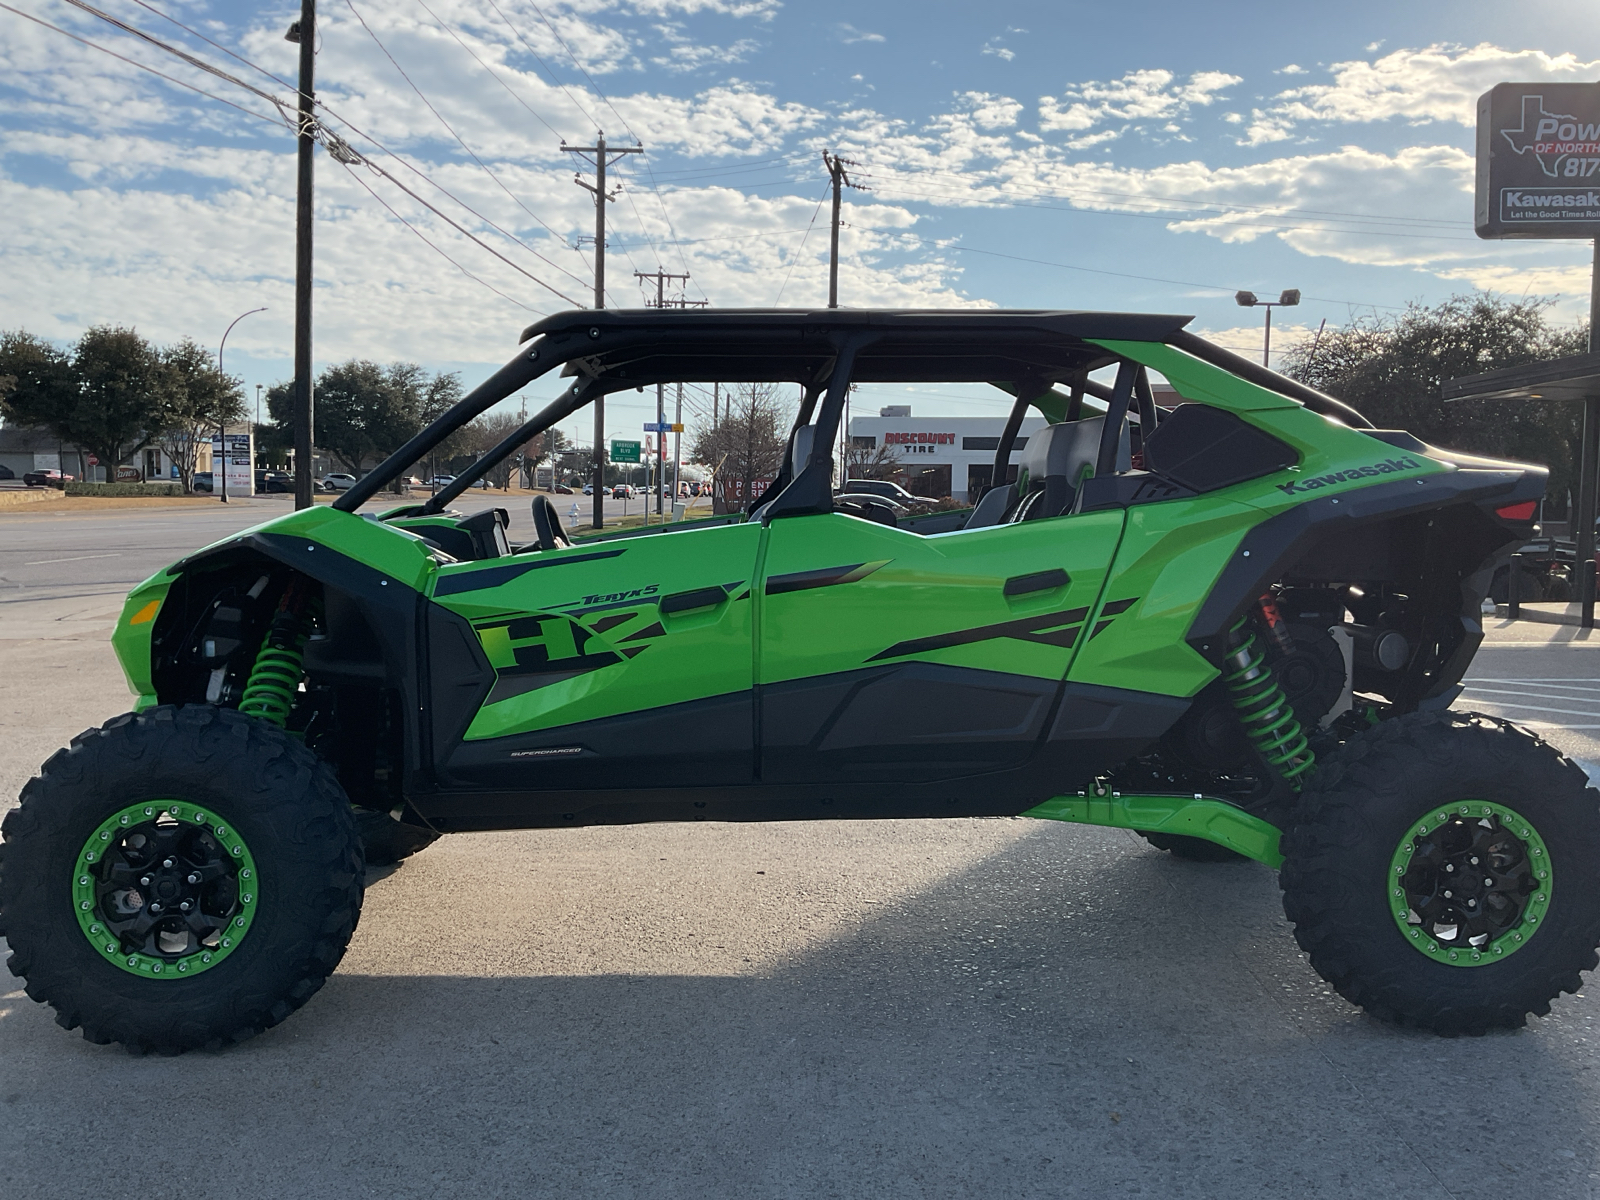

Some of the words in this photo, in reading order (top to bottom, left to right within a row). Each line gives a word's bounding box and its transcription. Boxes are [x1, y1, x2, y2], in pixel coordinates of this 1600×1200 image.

[1535, 143, 1554, 153] OF
[1555, 143, 1600, 153] NORTH
[1564, 158, 1600, 177] 817
[885, 432, 956, 444] DISCOUNT
[904, 445, 935, 453] TIRE
[1275, 456, 1421, 496] Kawasaki
[736, 489, 764, 497] CRE
[510, 747, 582, 757] SUPERCHARGED
